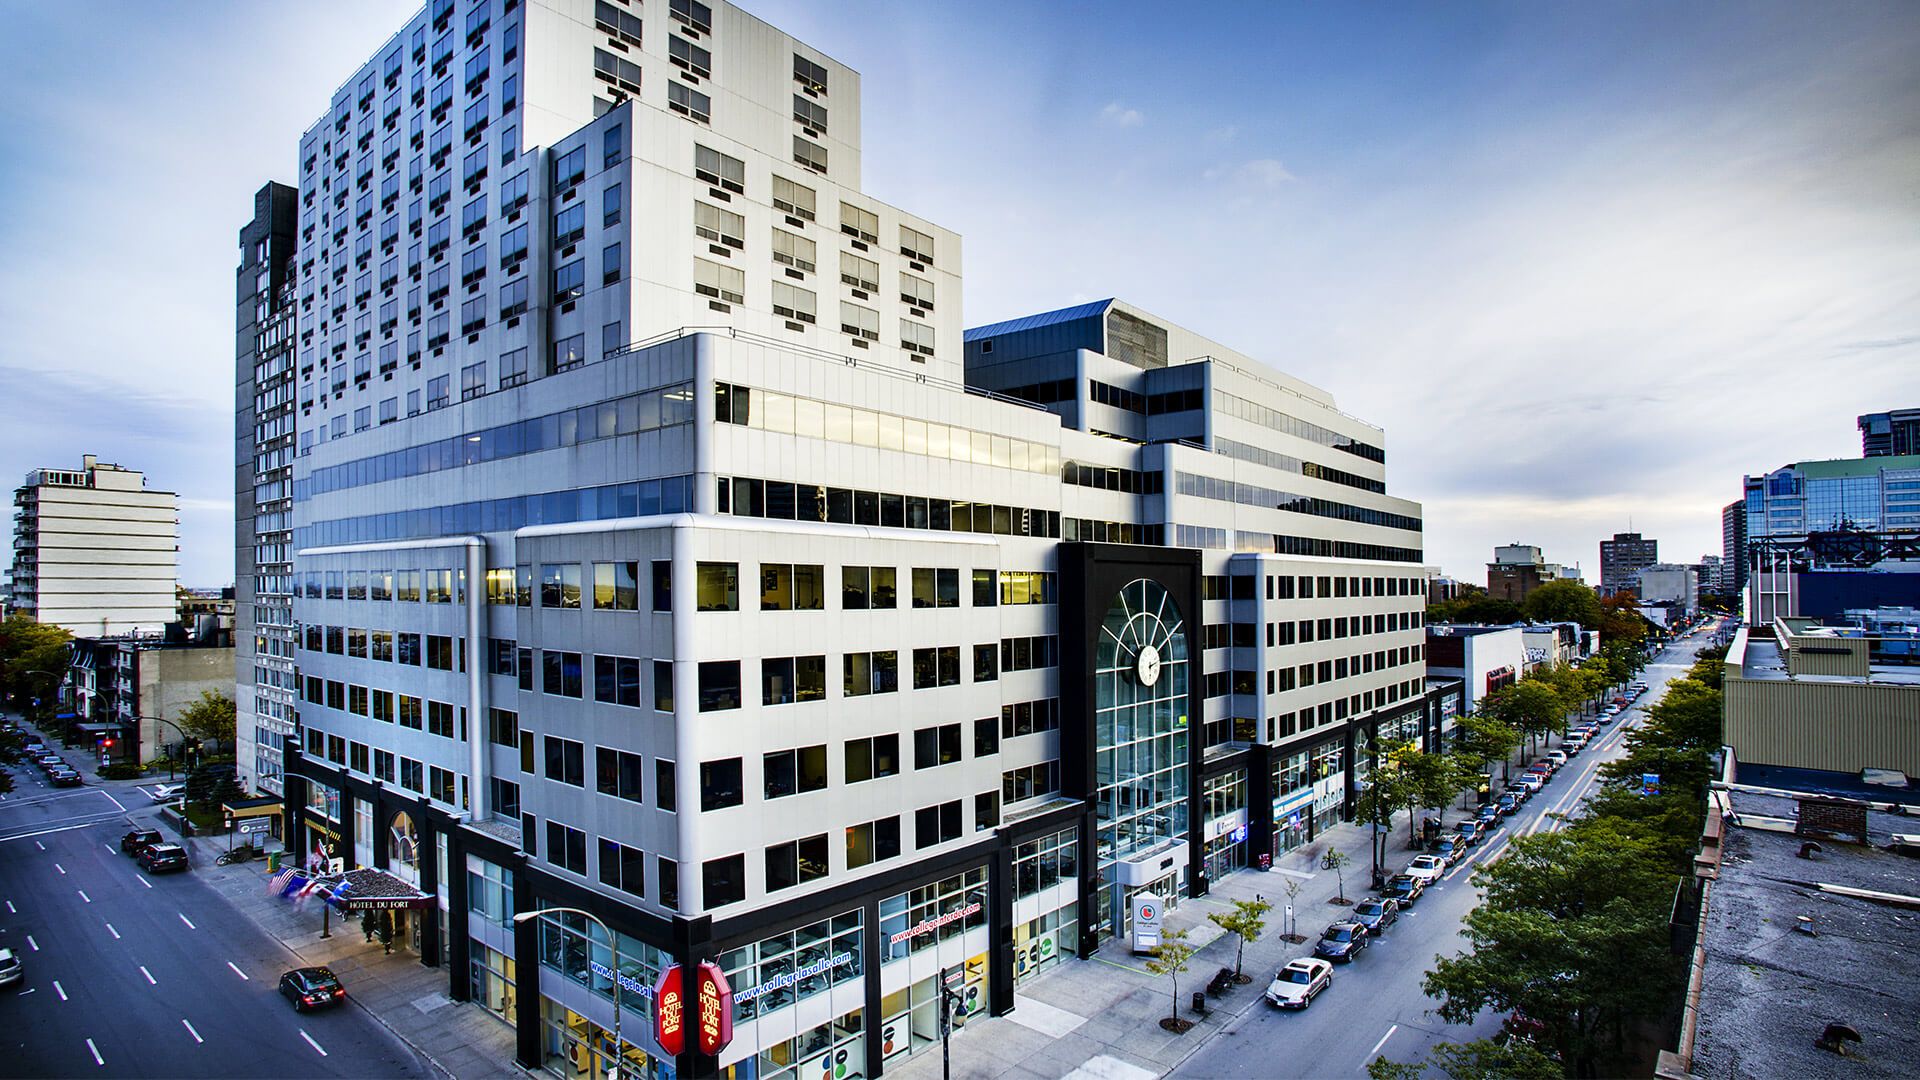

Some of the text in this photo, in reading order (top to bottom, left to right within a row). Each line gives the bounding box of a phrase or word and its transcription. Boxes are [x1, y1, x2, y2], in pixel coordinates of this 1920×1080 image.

[377, 901, 389, 909] DU
[391, 901, 409, 909] FORT
[734, 951, 851, 1004] www.collegelasalle.com
[665, 1008, 678, 1020] DU
[705, 1004, 716, 1017] DU
[662, 1015, 680, 1029] FORT
[702, 1012, 719, 1027] FORT
